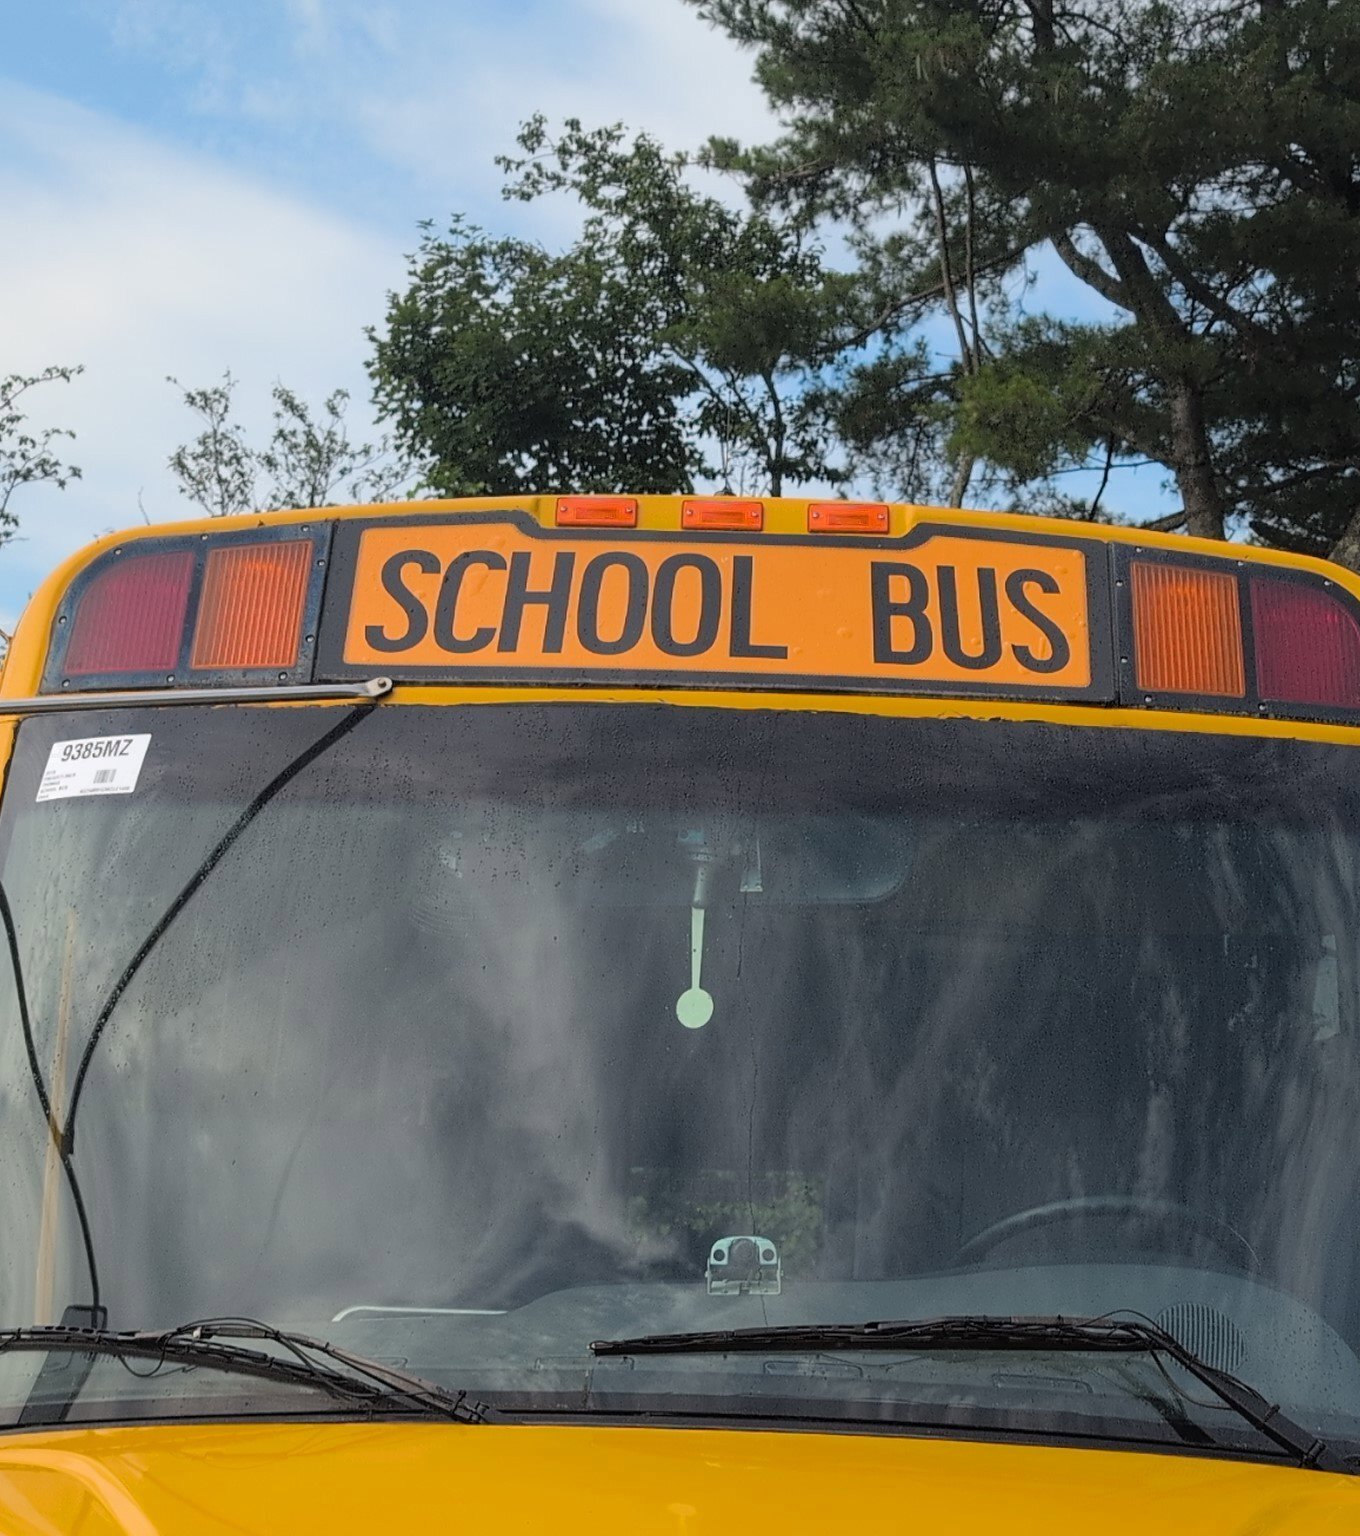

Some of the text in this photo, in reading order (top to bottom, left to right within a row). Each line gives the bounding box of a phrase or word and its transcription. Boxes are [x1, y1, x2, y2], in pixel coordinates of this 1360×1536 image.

[364, 549, 1071, 673] SCHOOL BUS
[61, 739, 133, 761] 9385MZ
